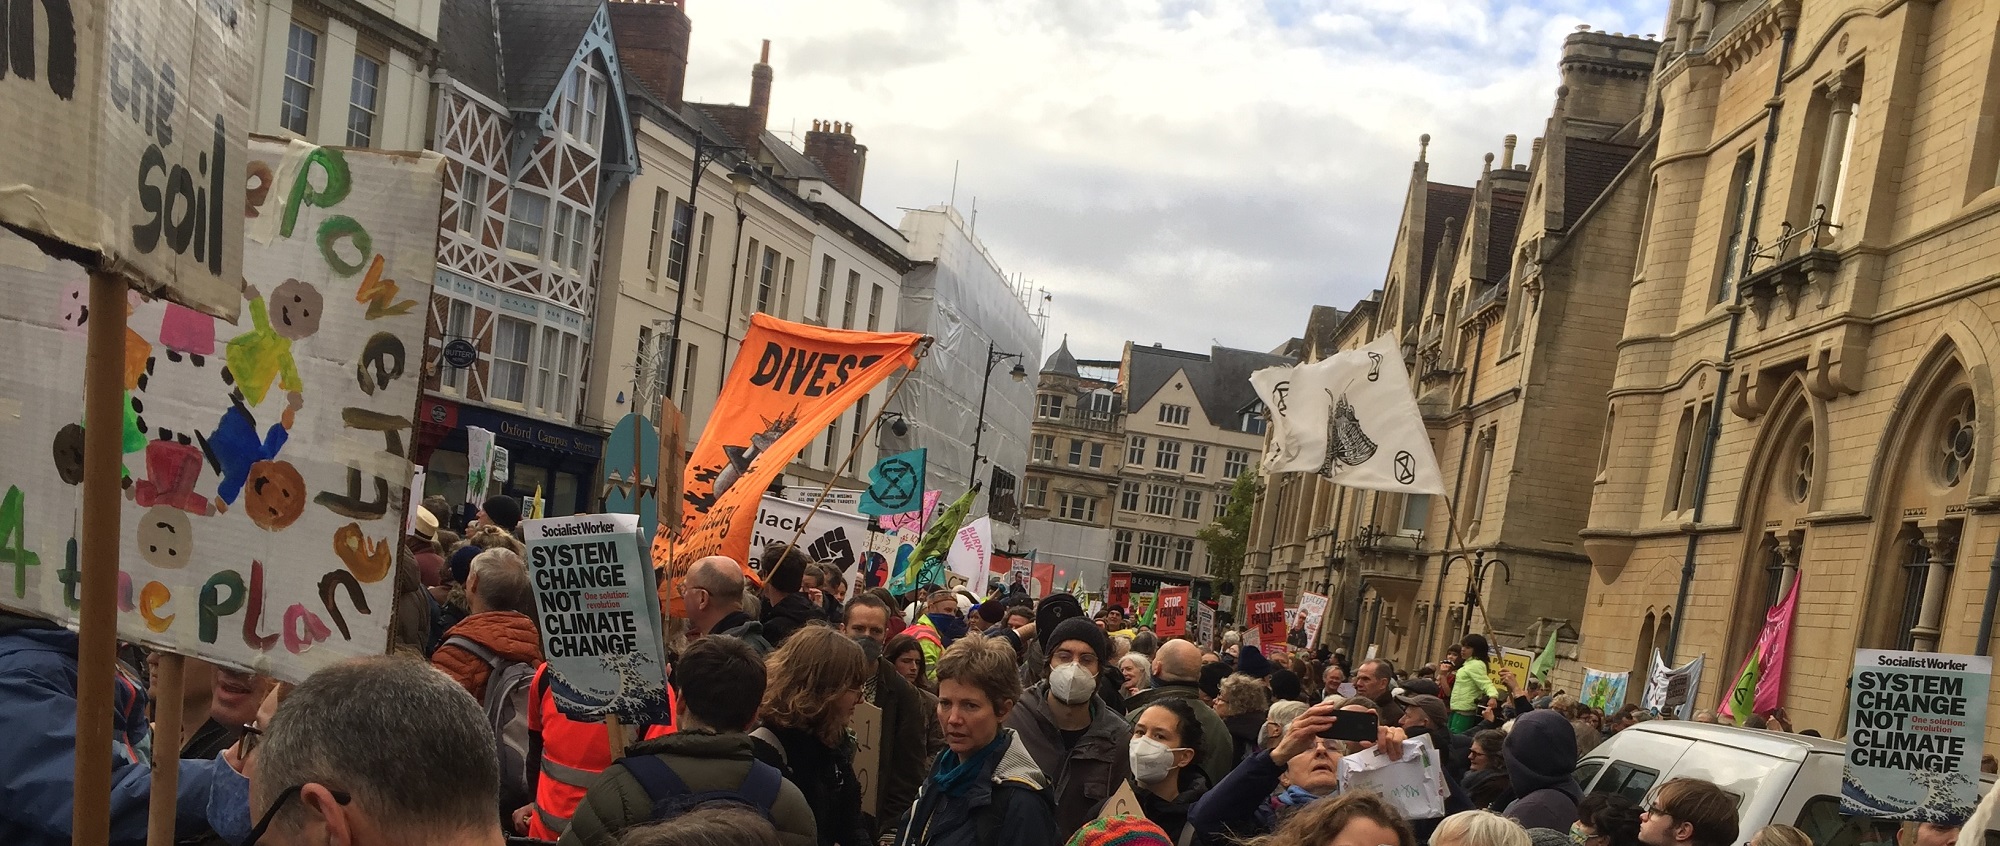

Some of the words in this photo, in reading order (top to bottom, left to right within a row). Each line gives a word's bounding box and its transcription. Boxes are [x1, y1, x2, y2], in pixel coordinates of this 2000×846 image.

[445, 349, 475, 359] BUTTERY
[500, 420, 532, 439] Oxford
[537, 429, 568, 449] Campus
[573, 437, 596, 453] Stores
[542, 523, 581, 538] Socialist
[581, 521, 615, 535] Worker
[755, 508, 806, 535] lack
[0, 484, 41, 599] 4
[958, 529, 976, 552] PINK
[531, 541, 619, 568] SYSTEM
[535, 565, 627, 591] CHANGE
[1114, 579, 1127, 588] STOP
[540, 590, 583, 613] NOT
[584, 592, 598, 601] One
[600, 591, 630, 600] solution:
[586, 600, 621, 609] revolution
[1164, 596, 1182, 608] STOP
[1160, 606, 1184, 618] FAILING
[1255, 601, 1276, 614] STOP
[544, 611, 637, 635] CLIMATE
[1166, 617, 1176, 627] US
[1251, 611, 1282, 625] FAILING
[1262, 623, 1274, 635] US
[549, 634, 638, 658] CHANGE
[1878, 655, 1927, 669] Socialist
[1927, 657, 1968, 671] Worker
[1857, 671, 1963, 697] SYSTEM
[1856, 690, 1967, 717] CHANGE
[1855, 710, 1908, 731] NOT
[1911, 715, 1928, 724] One
[1930, 717, 1966, 727] solution:
[1911, 724, 1952, 734] revolution
[1852, 728, 1966, 756] CLIMATE
[1850, 748, 1961, 774] CHANGE
